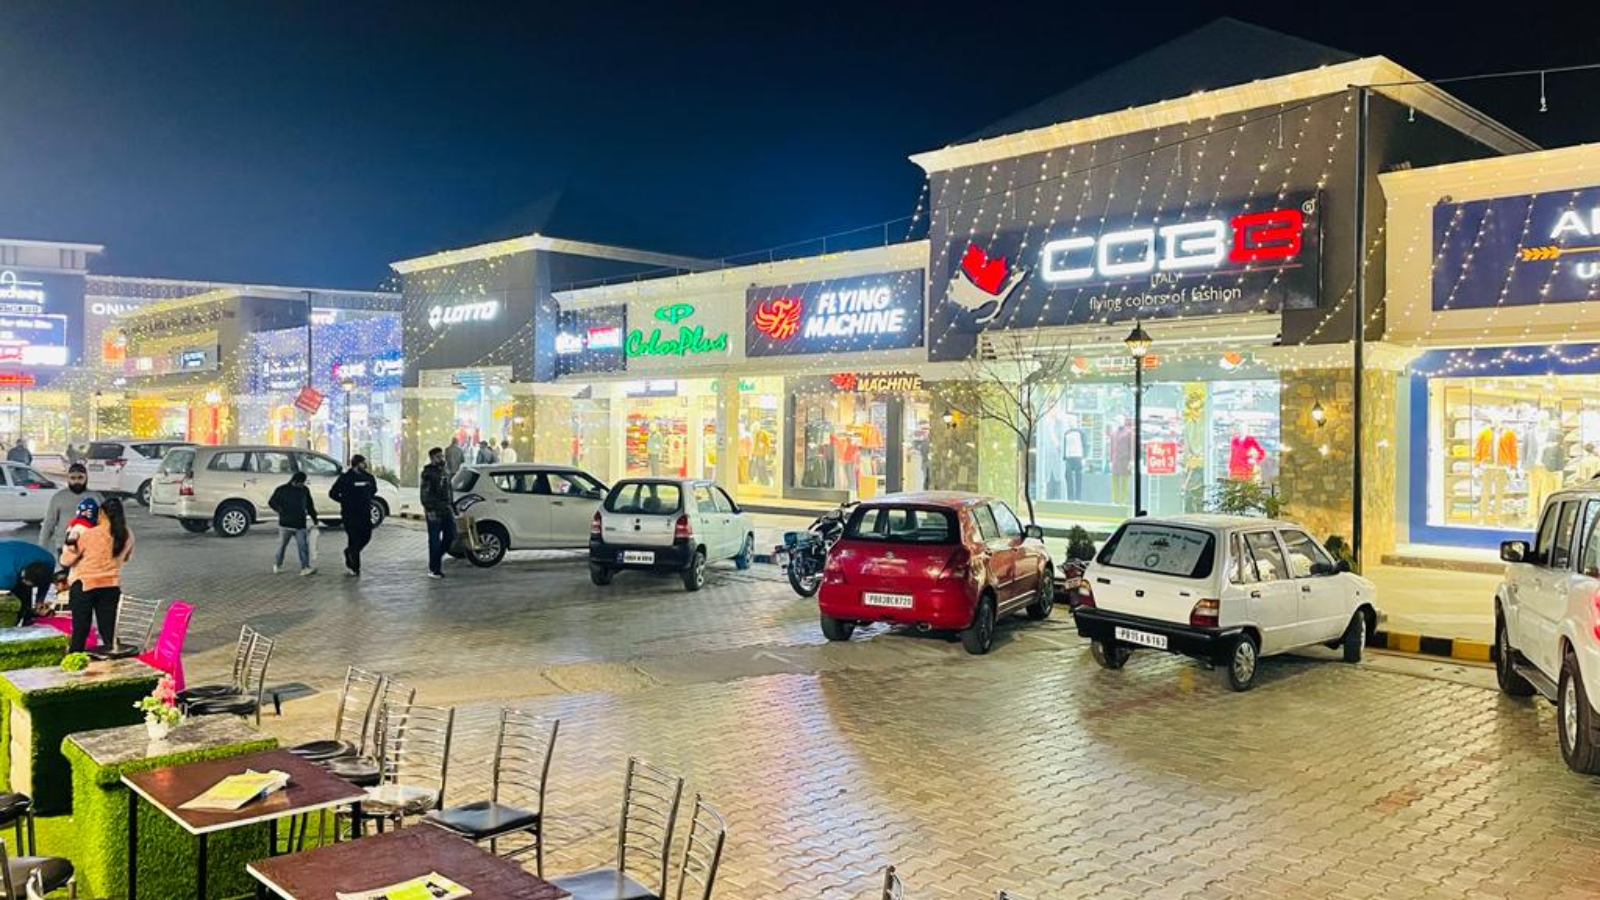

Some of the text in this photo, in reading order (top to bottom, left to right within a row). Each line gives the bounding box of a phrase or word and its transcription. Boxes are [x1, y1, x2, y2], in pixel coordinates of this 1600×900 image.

[1043, 208, 1303, 282] COBB
[1151, 273, 1181, 287] ITALY
[1576, 261, 1600, 280] U
[442, 300, 499, 324] LOTTO
[818, 286, 891, 314] FLYING
[1089, 286, 1241, 313] flying colors of fashion
[804, 309, 906, 338] MACHINE
[626, 324, 728, 357] ColorPlus
[857, 376, 922, 391] MACHINE
